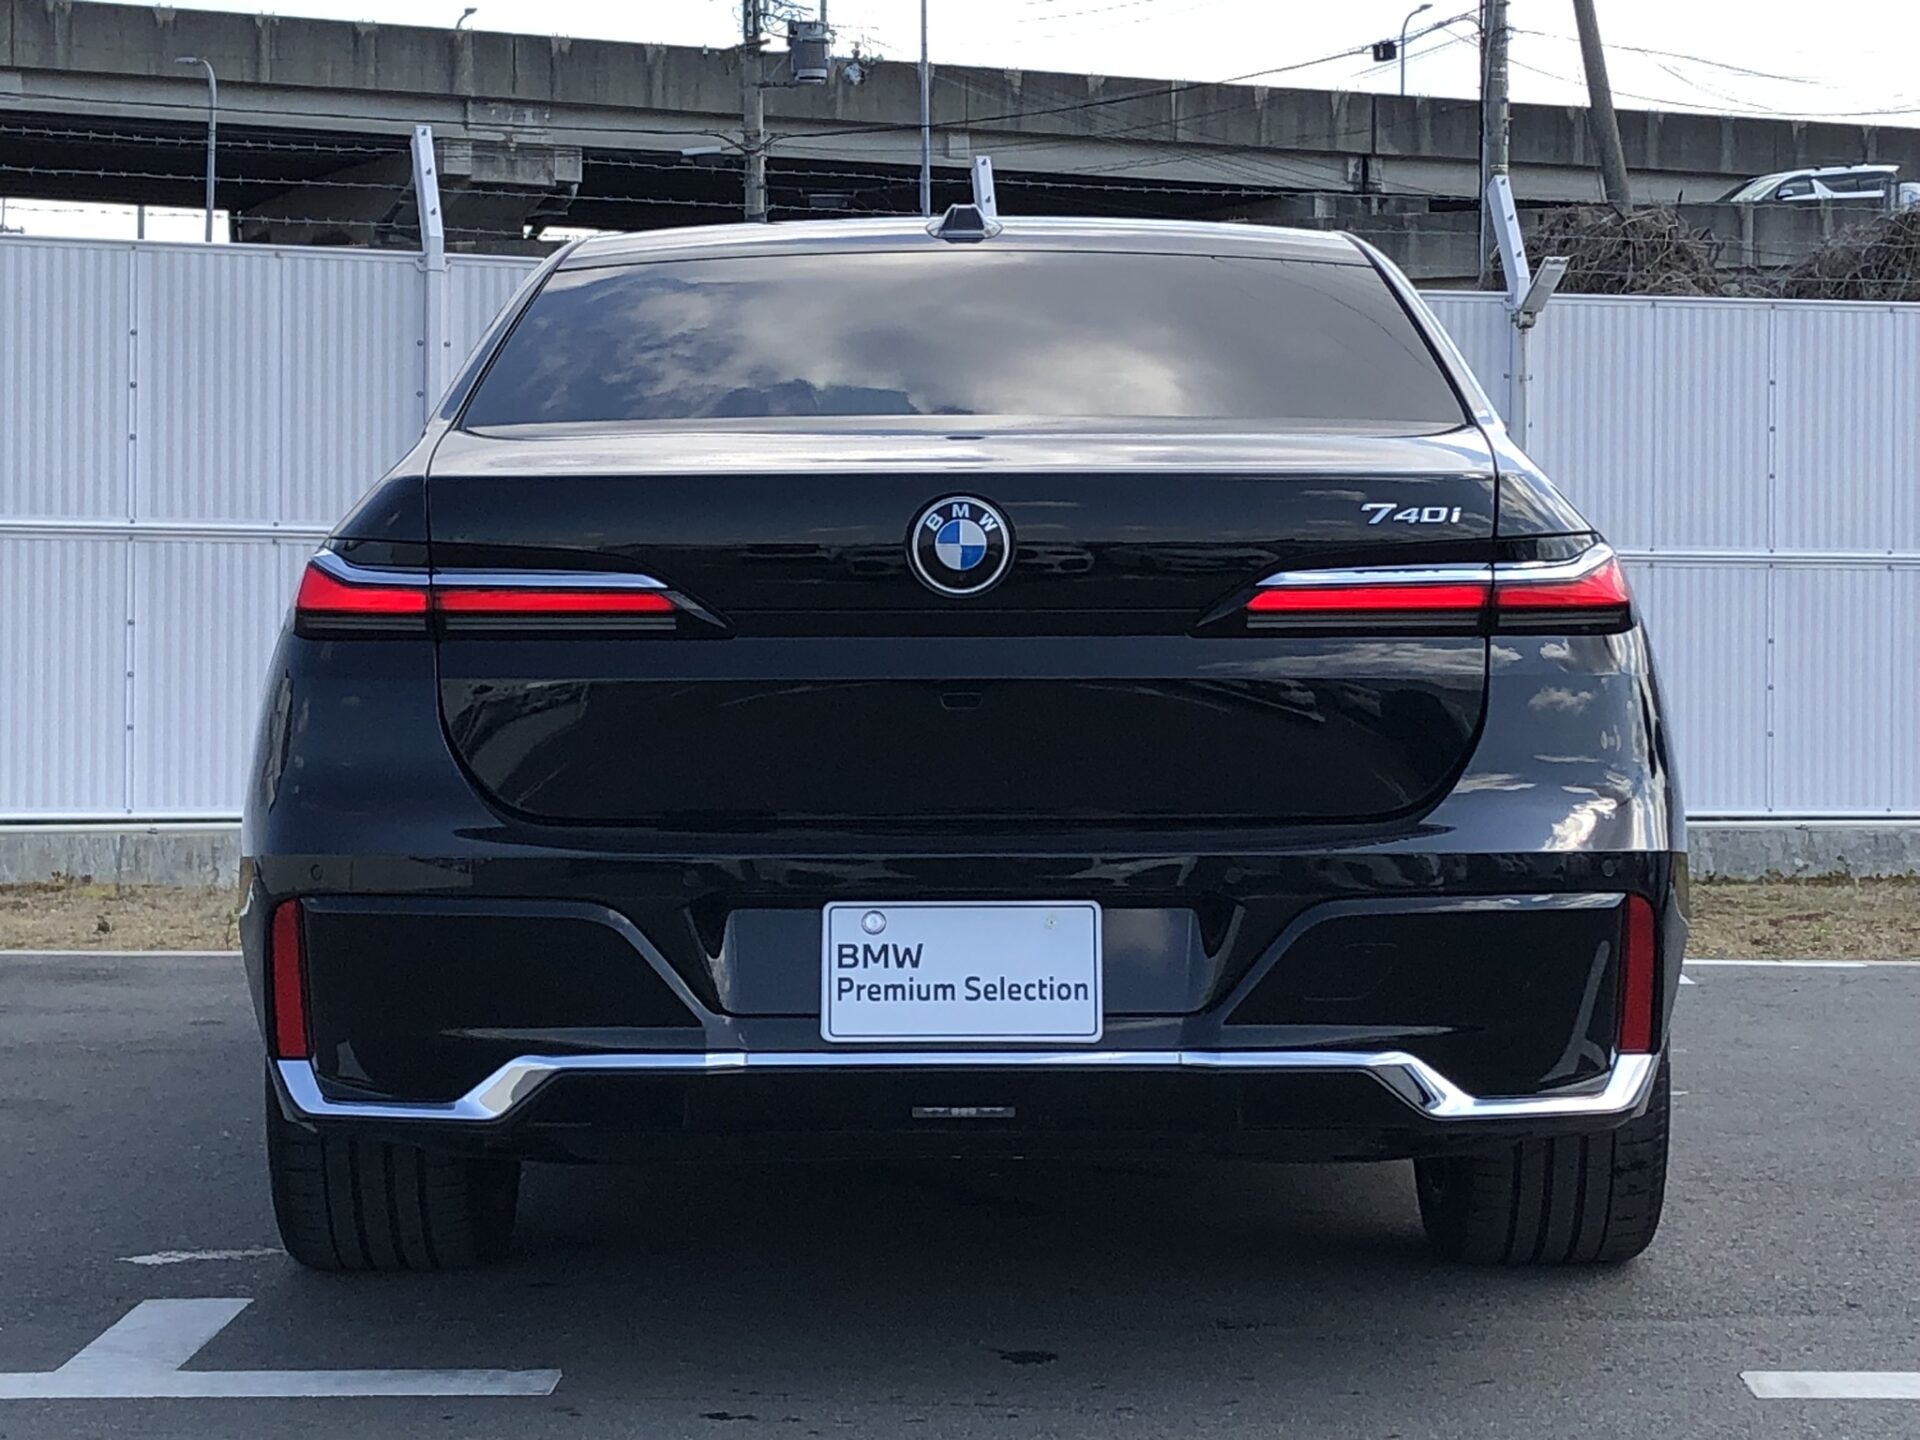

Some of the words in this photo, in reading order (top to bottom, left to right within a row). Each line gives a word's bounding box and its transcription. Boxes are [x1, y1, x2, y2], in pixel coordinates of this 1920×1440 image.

[925, 503, 998, 532] BMW
[1361, 503, 1462, 524] 740i
[837, 943, 923, 969] BMW
[837, 976, 956, 1001] Premium
[964, 976, 1089, 1001] Selection
